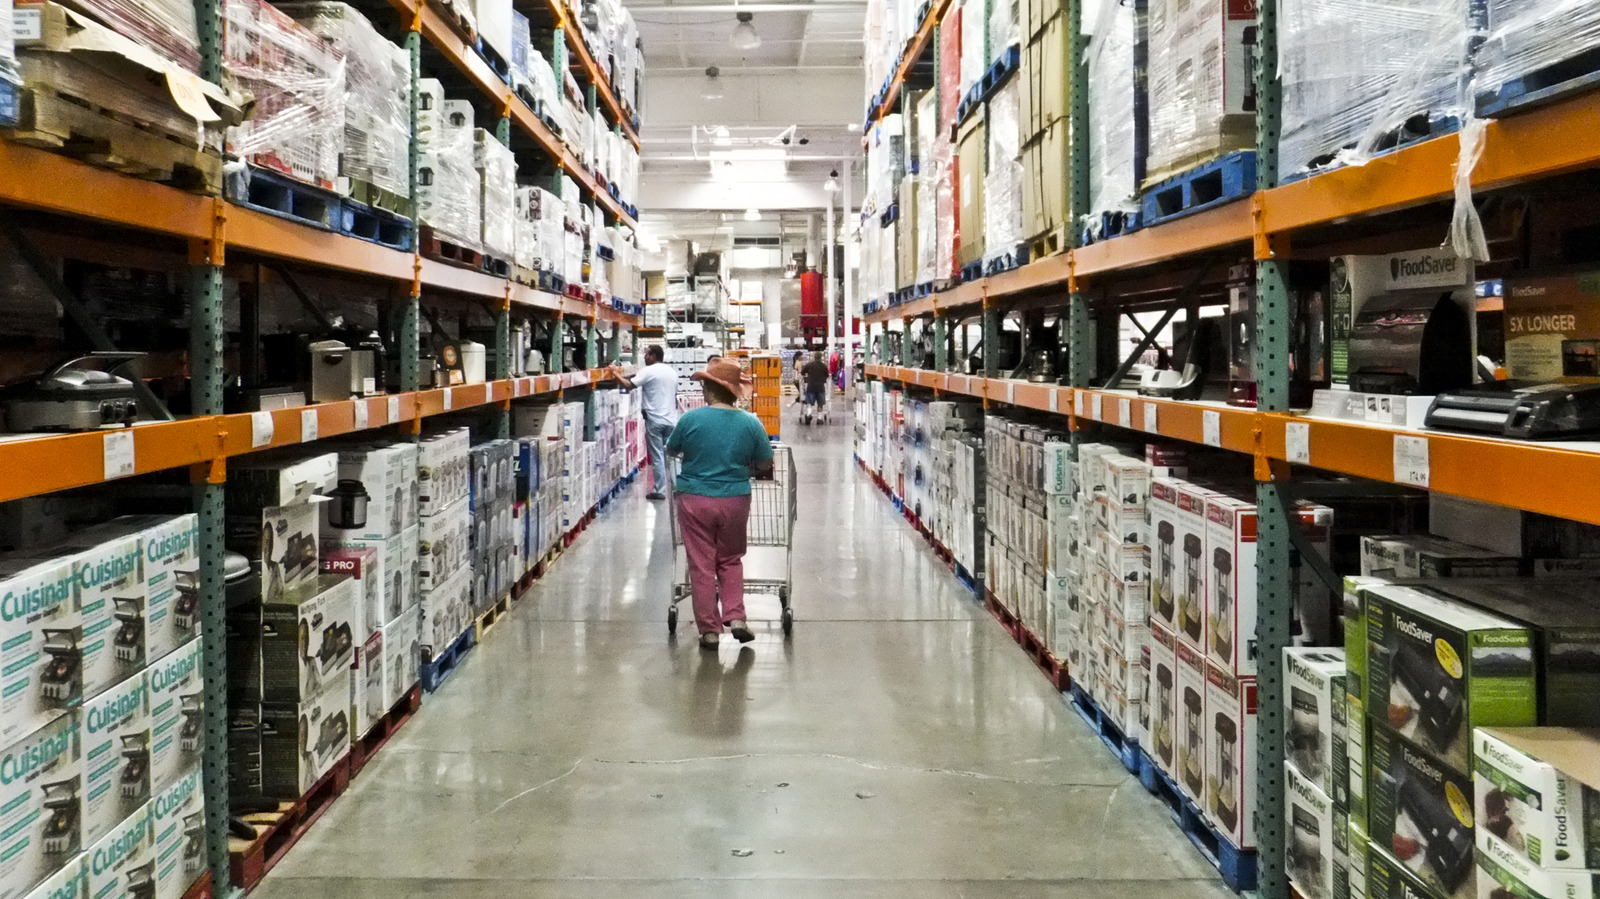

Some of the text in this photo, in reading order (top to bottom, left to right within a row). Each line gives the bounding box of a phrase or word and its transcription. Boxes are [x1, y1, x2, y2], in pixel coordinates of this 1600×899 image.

[1400, 256, 1457, 276] FoodSaver
[1512, 286, 1546, 297] FoodSaver
[1527, 314, 1576, 332] LONGER
[1054, 449, 1063, 492] Cuisinart
[148, 527, 199, 562] Cuisinart
[81, 548, 143, 589] Cuisinart
[333, 561, 355, 570] PRO
[1, 571, 80, 622] Cuisinart
[1396, 615, 1433, 644] FoodSaver
[151, 647, 203, 693] Cuisinart
[1293, 658, 1325, 691] FoodSaver
[87, 681, 148, 734] Cuisinart
[1, 721, 80, 785] Cuisinart
[1404, 748, 1443, 782] FoodSaver
[1488, 743, 1524, 774] FoodSaver
[1293, 774, 1327, 814] FoodSaver
[1555, 778, 1568, 847] FoodSaver
[93, 810, 154, 876] Cuisinart
[1493, 842, 1530, 876] FoodSaver
